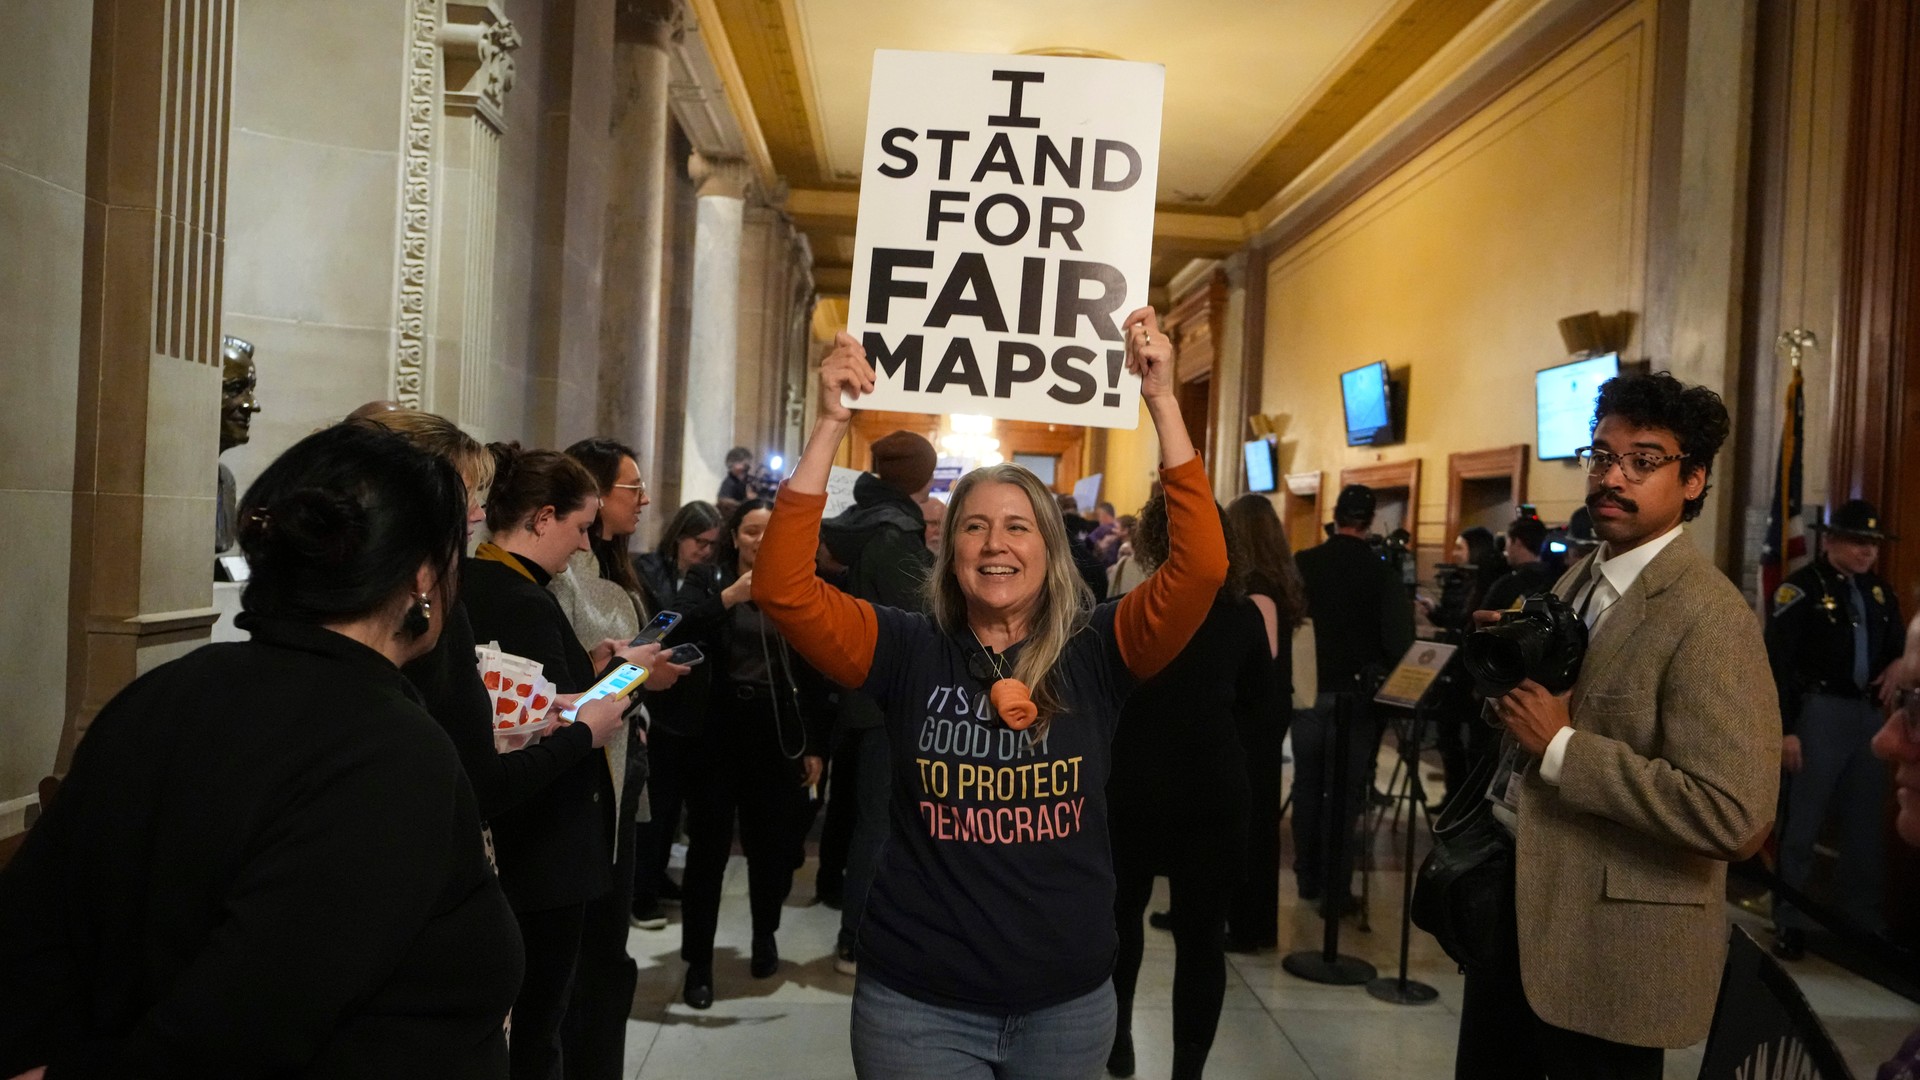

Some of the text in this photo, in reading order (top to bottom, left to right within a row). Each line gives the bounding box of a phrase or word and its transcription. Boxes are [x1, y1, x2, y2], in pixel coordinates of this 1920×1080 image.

[988, 70, 1045, 128] I
[877, 127, 1143, 192] STAND
[926, 190, 1086, 251] FOR
[865, 247, 1128, 342] FAIR
[862, 331, 1126, 408] MAPS!
[918, 715, 1051, 760] GOOD DAY
[916, 756, 1083, 801] TO PROTECT
[919, 797, 1085, 845] DEMOCRACY
